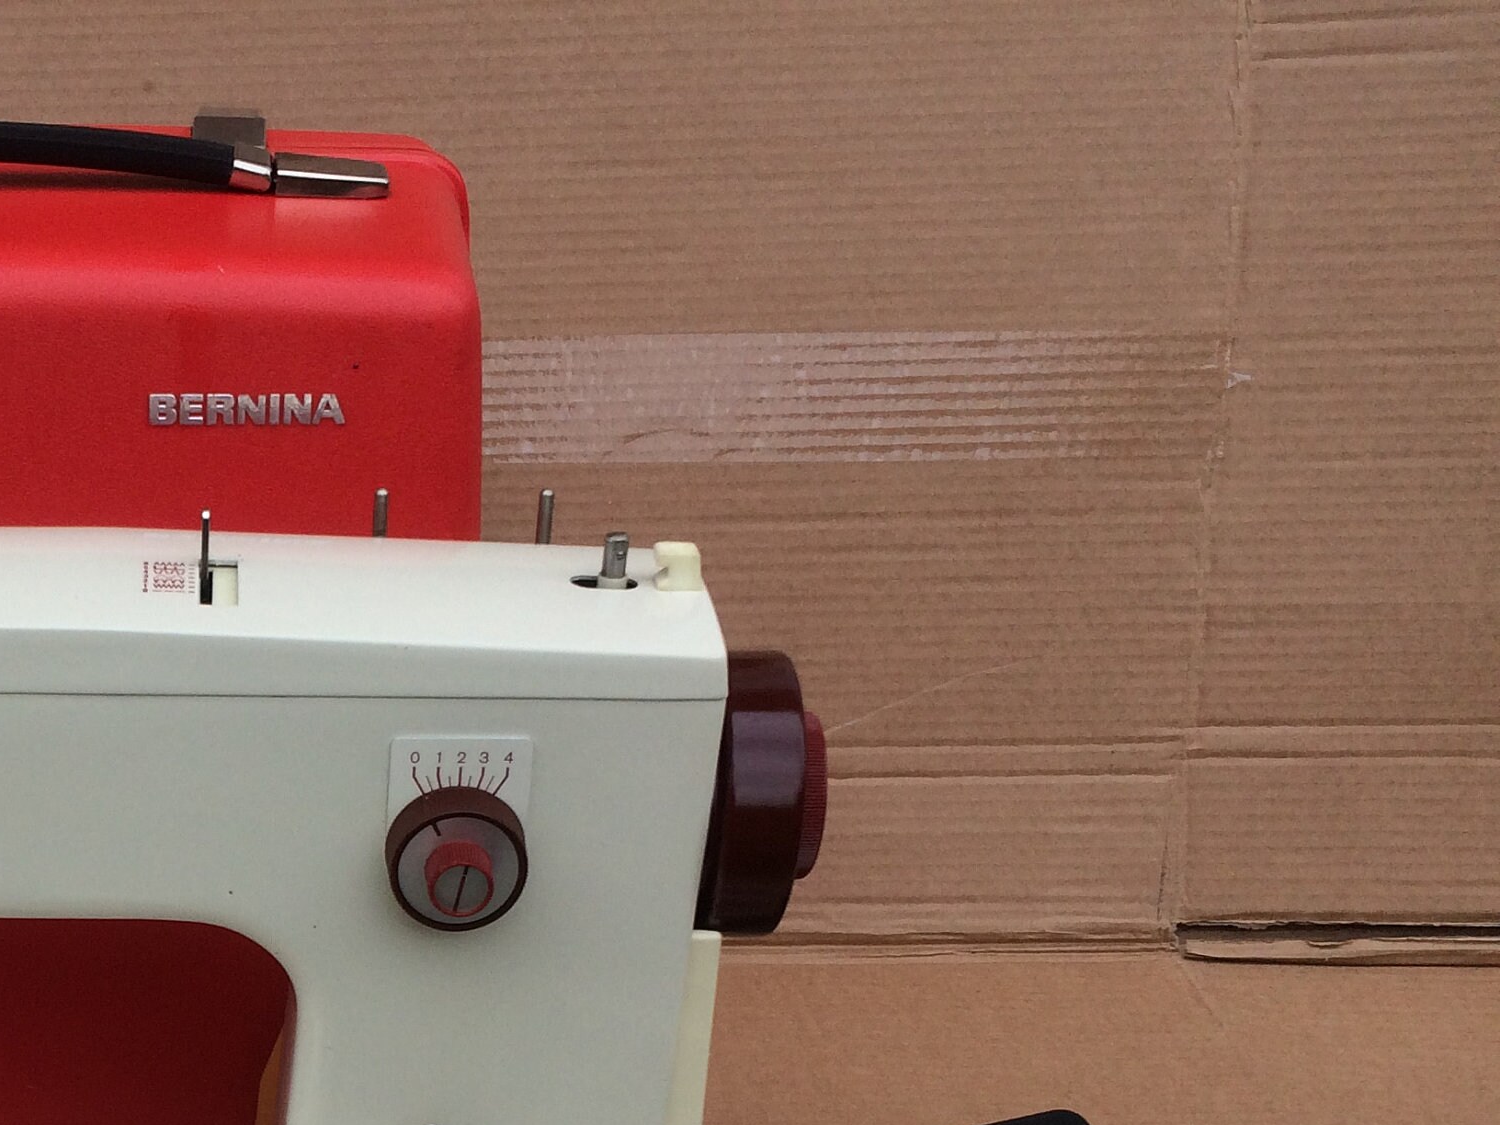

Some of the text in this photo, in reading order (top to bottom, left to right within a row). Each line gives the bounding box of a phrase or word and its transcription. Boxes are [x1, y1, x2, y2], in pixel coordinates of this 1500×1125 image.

[149, 393, 345, 426] BERNINA
[410, 751, 513, 764] 0 1 2 3 4
